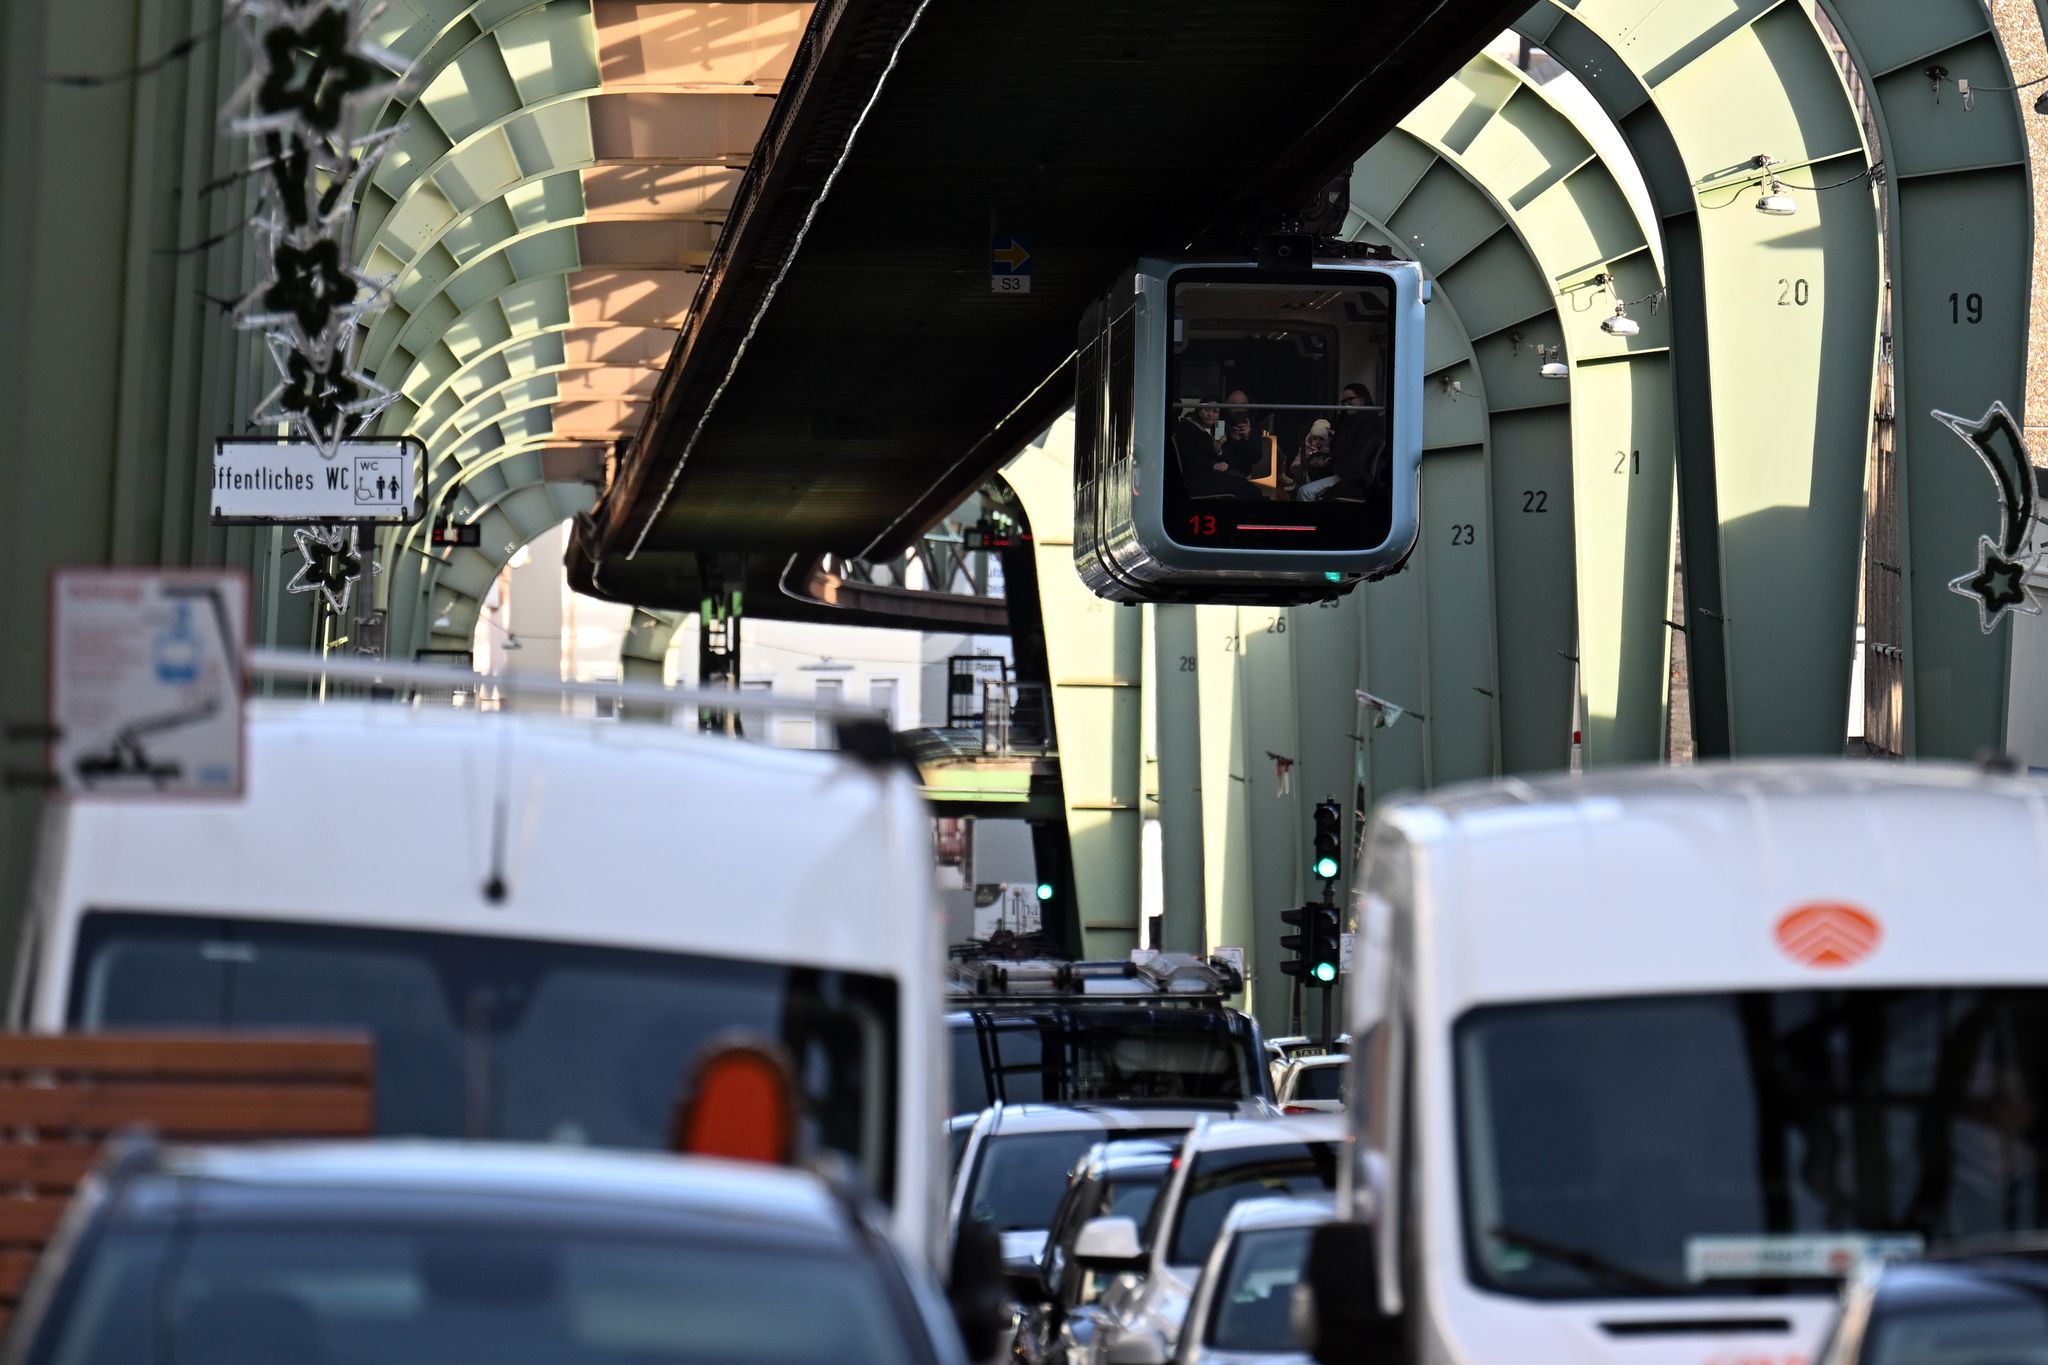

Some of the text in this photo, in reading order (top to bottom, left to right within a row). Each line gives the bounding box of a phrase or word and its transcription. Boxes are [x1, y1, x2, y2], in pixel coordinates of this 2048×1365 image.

[1002, 277, 1020, 290] S3
[1777, 278, 1809, 306] 20
[1948, 292, 1983, 324] 19
[360, 461, 380, 471] WC
[1613, 450, 1640, 475] 21
[326, 467, 349, 490] WC
[1522, 490, 1548, 513] 22
[1188, 515, 1217, 535] 13
[1451, 524, 1475, 546] 23
[1266, 616, 1286, 633] 26
[1224, 636, 1240, 652] 27
[1179, 656, 1197, 672] 28
